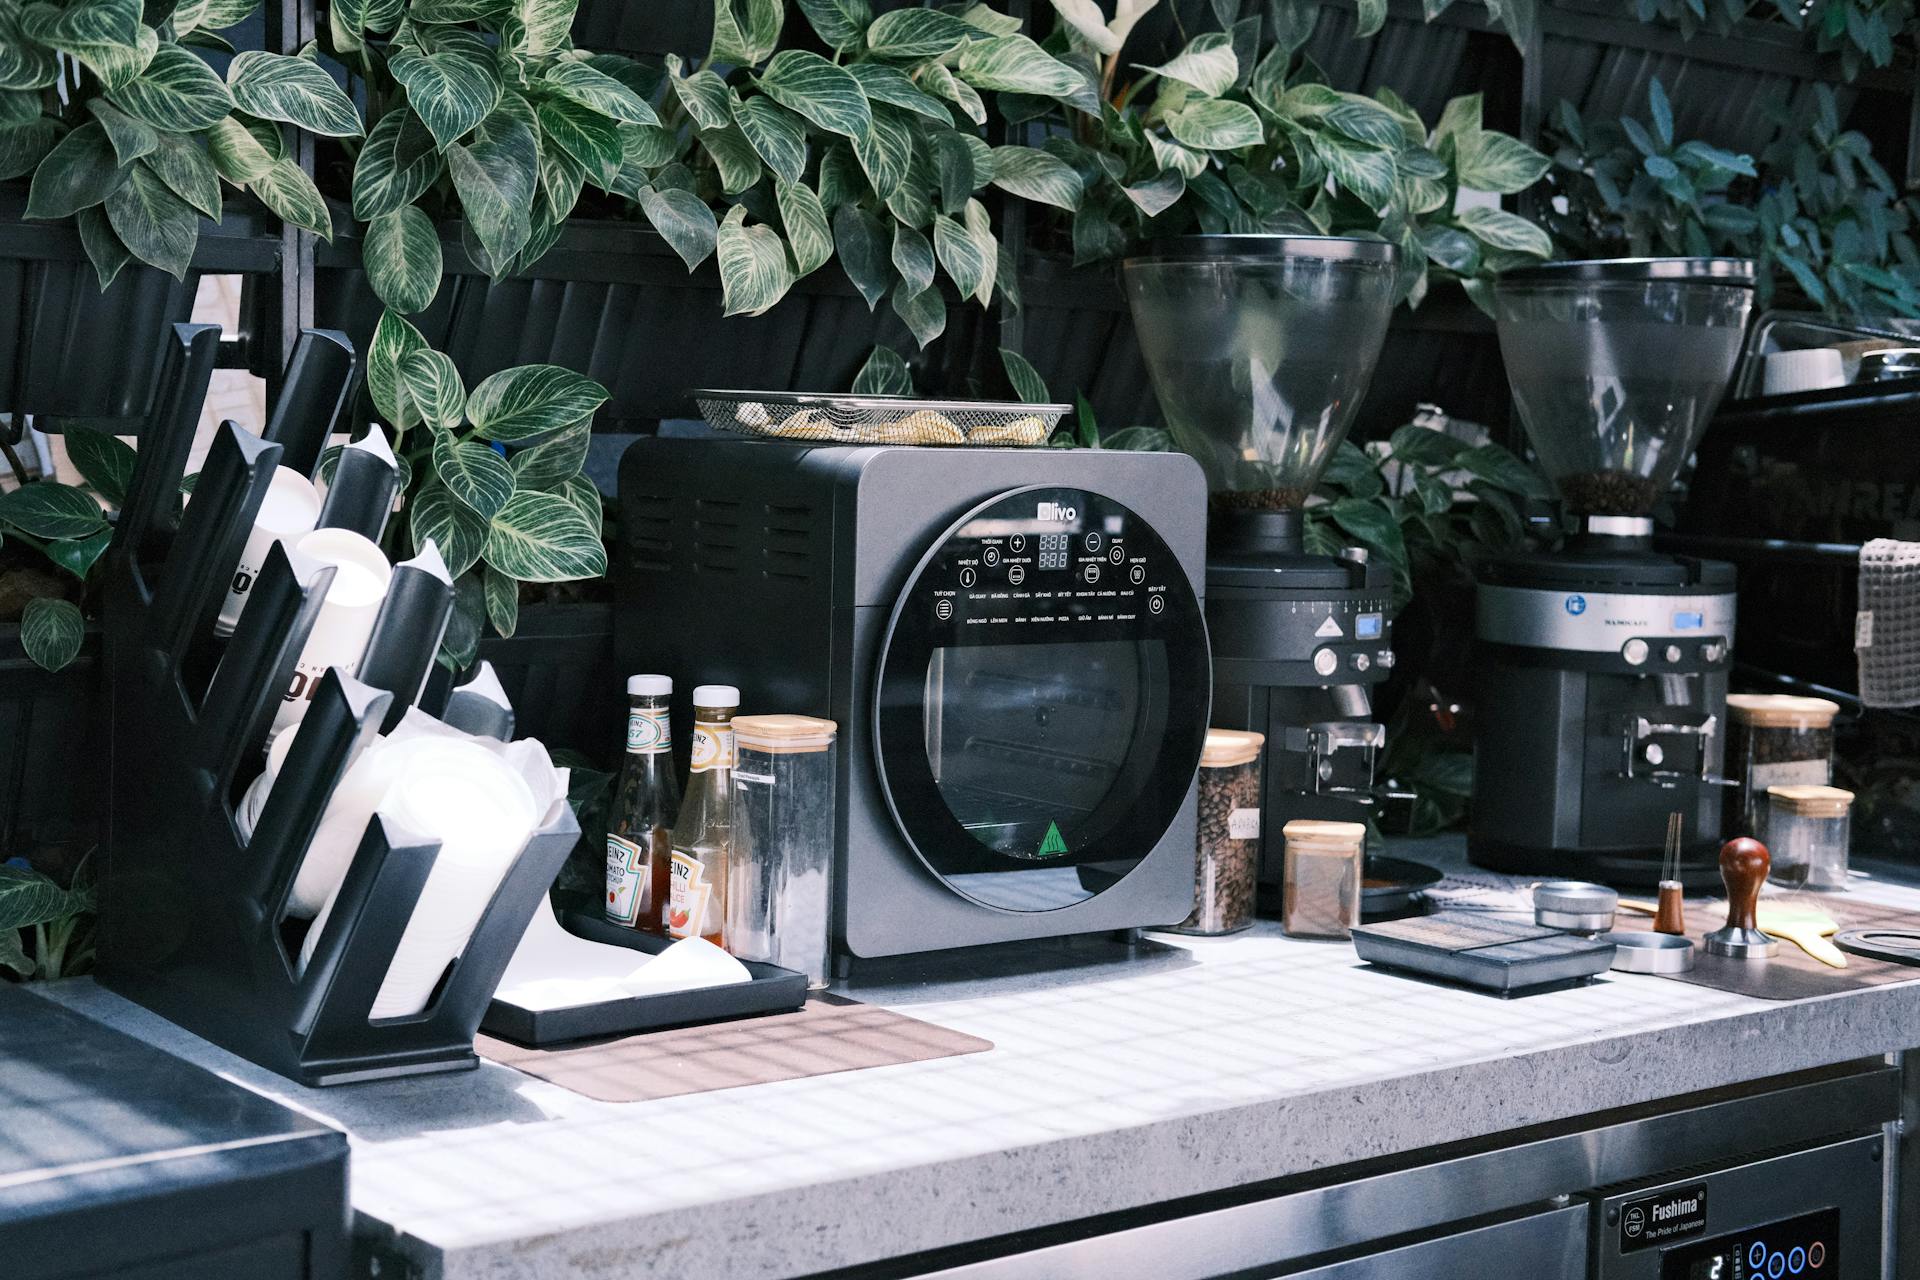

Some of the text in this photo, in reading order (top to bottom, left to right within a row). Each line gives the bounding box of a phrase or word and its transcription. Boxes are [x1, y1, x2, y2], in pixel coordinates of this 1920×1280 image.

[606, 845, 625, 863] EINZ
[606, 863, 625, 877] OMATO
[670, 861, 689, 880] EINZ
[1652, 1199, 1698, 1223] Fushima
[1645, 1219, 1705, 1239] The Pride of Japanese
[1710, 1255, 1723, 1280] 2
